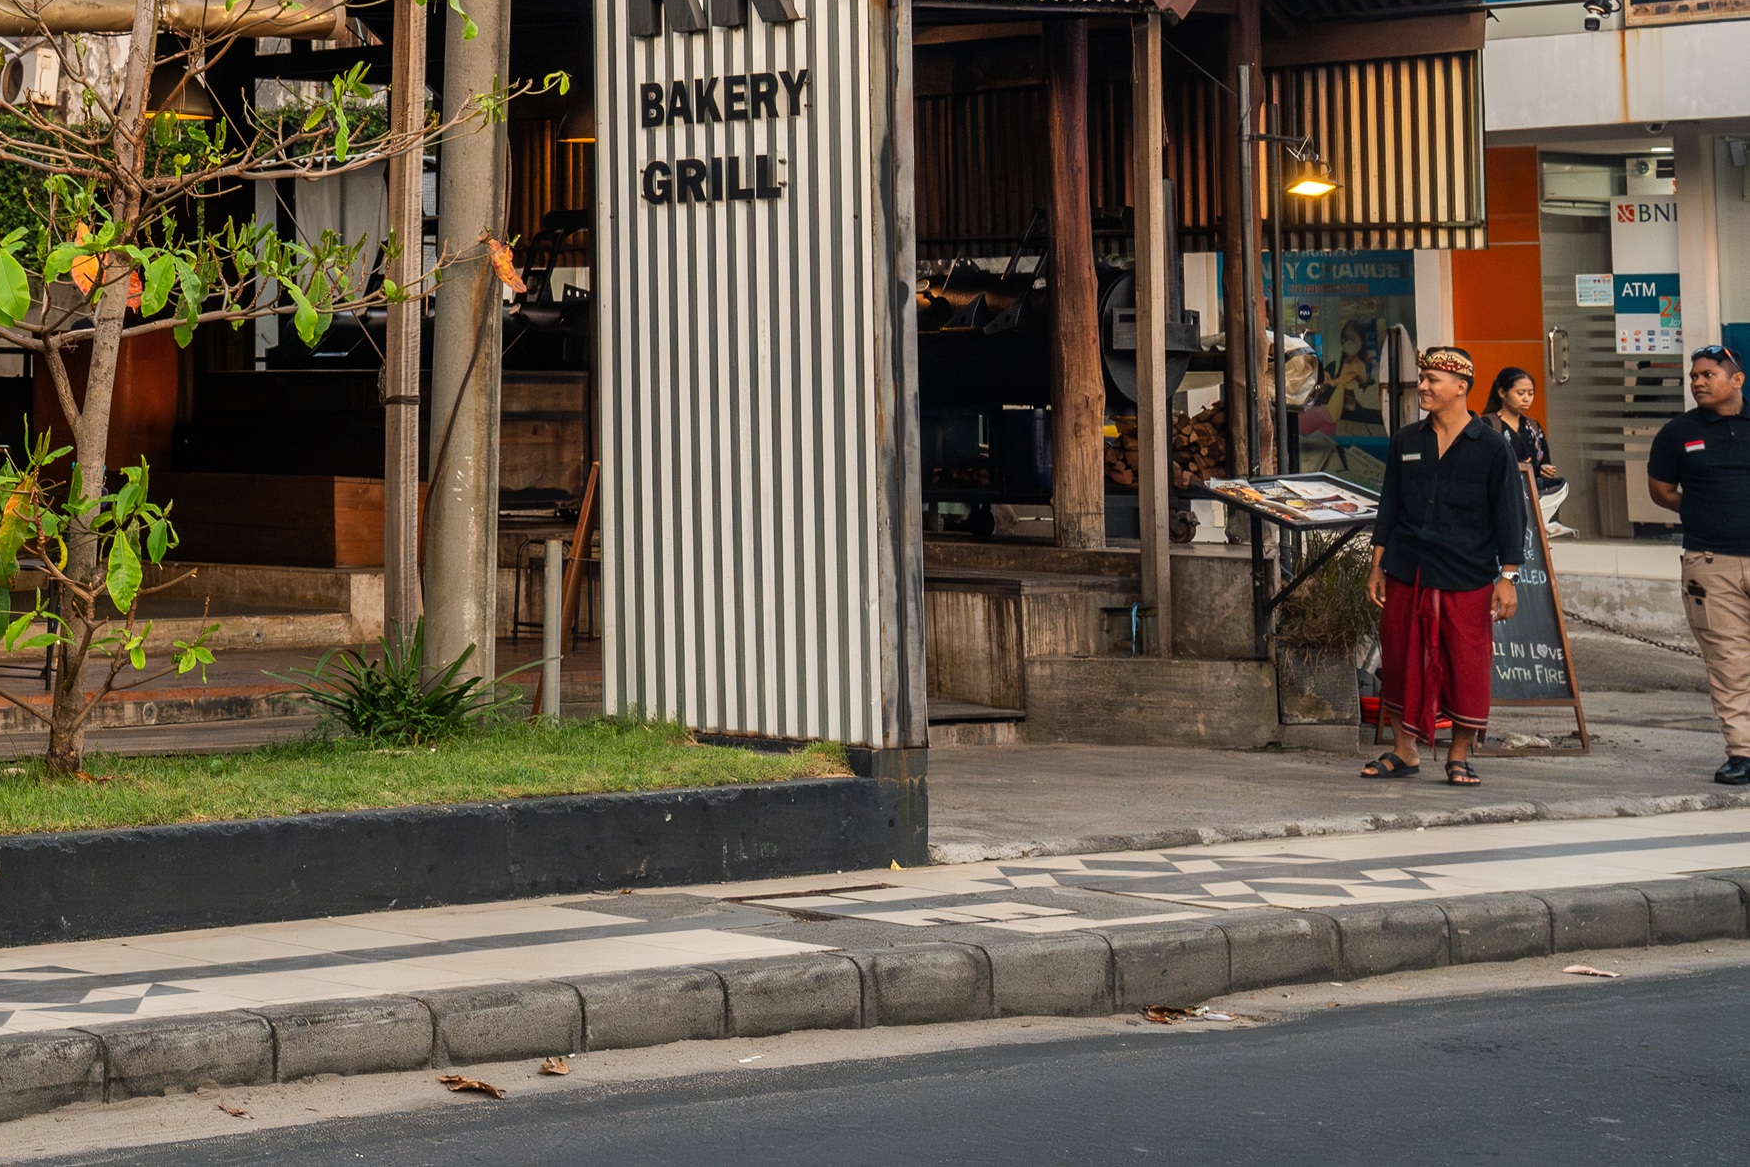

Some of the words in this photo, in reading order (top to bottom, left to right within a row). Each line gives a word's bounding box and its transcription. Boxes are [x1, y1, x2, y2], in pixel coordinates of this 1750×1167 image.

[640, 69, 808, 129] BAKERY
[641, 154, 783, 206] GRILL
[1638, 202, 1678, 223] BNI
[1621, 282, 1656, 297] ATM
[1510, 640, 1525, 658] IN
[1496, 664, 1532, 682] WITH
[1534, 664, 1567, 685] FIRE
